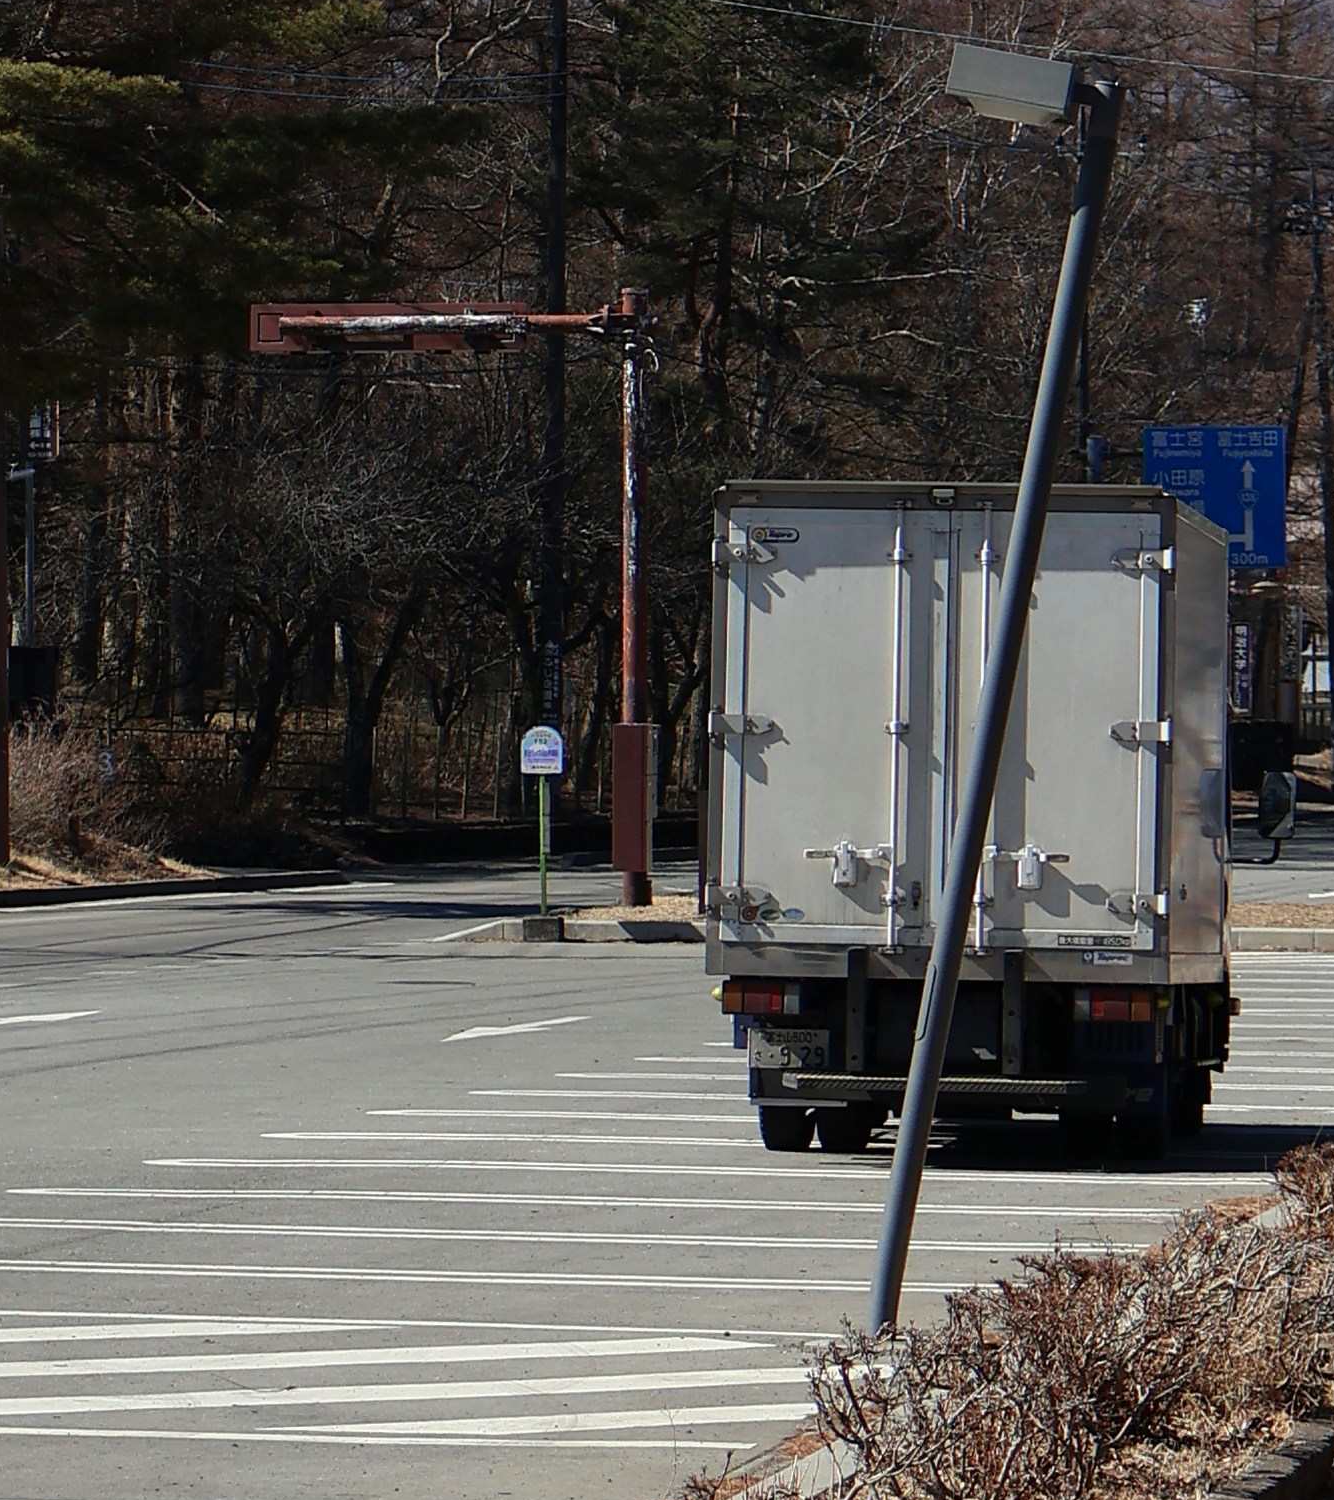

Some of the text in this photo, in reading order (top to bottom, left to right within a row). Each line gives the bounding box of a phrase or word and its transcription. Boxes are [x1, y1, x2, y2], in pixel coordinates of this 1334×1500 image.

[1151, 430, 1203, 447] 富士宮
[1217, 430, 1278, 447] 富士吉田
[1153, 469, 1205, 486] 小田原
[1230, 553, 1269, 565] 300m
